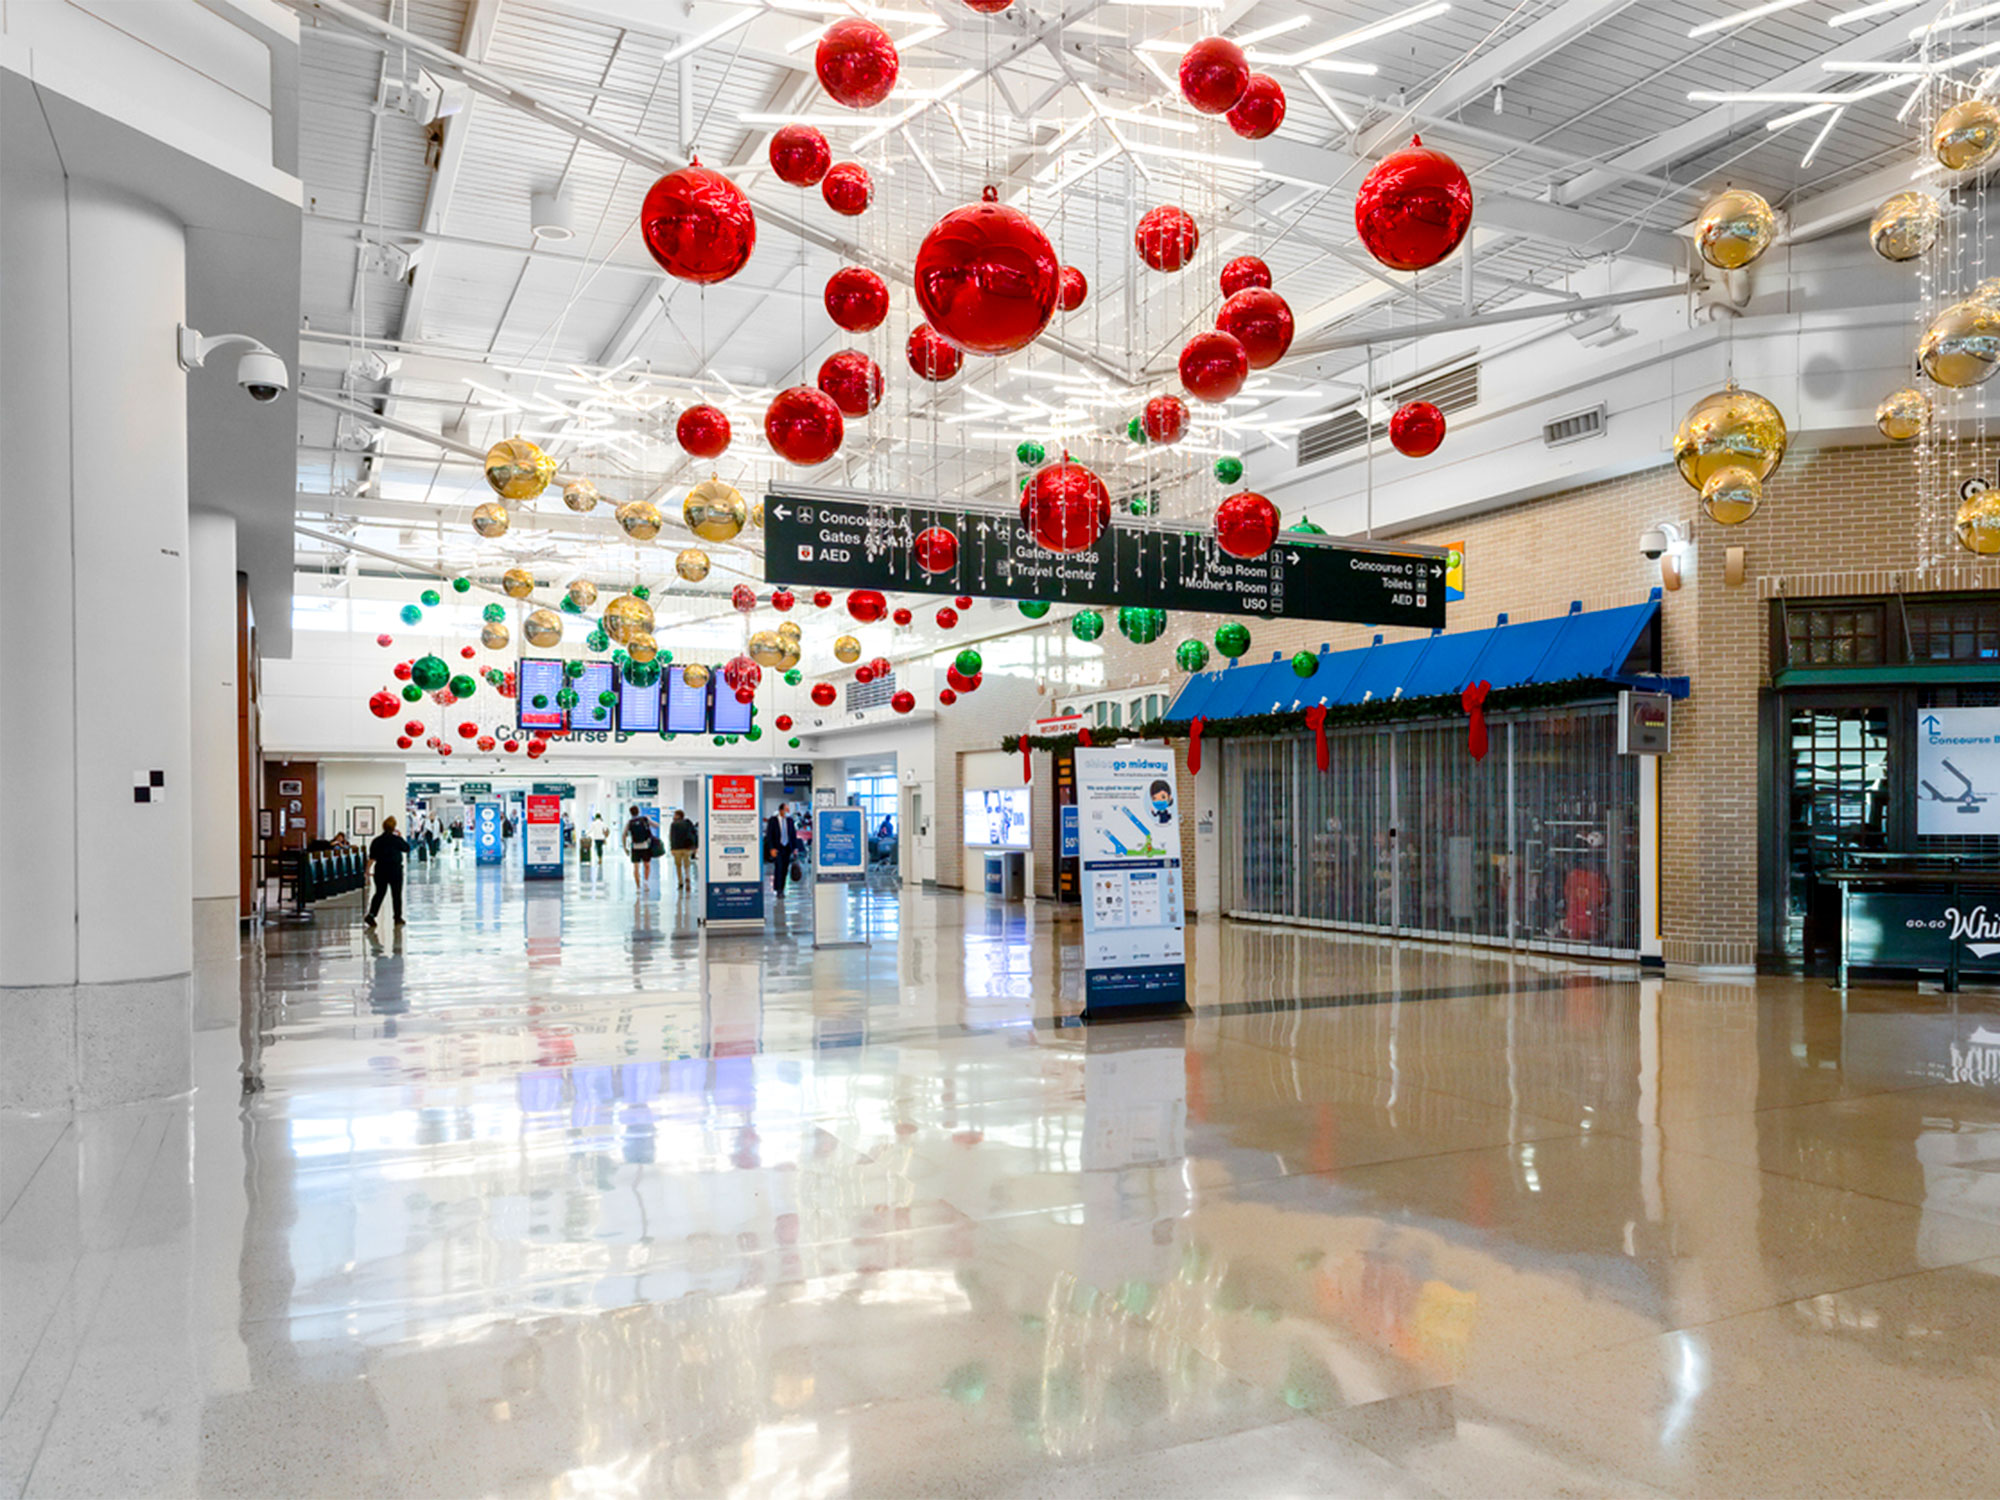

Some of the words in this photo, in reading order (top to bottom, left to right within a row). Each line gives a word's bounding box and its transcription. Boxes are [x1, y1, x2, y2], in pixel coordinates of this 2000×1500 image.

[819, 510, 894, 529] Concourse
[819, 529, 860, 545] Gates
[819, 549, 851, 562] AED
[1016, 545, 1052, 560] Gates
[1016, 563, 1053, 577] Travel
[1056, 566, 1096, 580] Center
[1206, 561, 1233, 576] Yoga
[1235, 564, 1267, 578] Room
[1350, 558, 1403, 574] Concourse
[1405, 563, 1413, 575] C
[1185, 577, 1233, 591] Mother's
[1235, 581, 1267, 593] Room
[1382, 577, 1413, 590] Toilets
[1242, 598, 1267, 610] USO
[1391, 594, 1413, 605] AED
[495, 724, 607, 743] Conourse
[615, 730, 628, 743] B
[1929, 736, 1991, 745] Concourse
[785, 764, 799, 775] B1
[1129, 759, 1168, 772] midway
